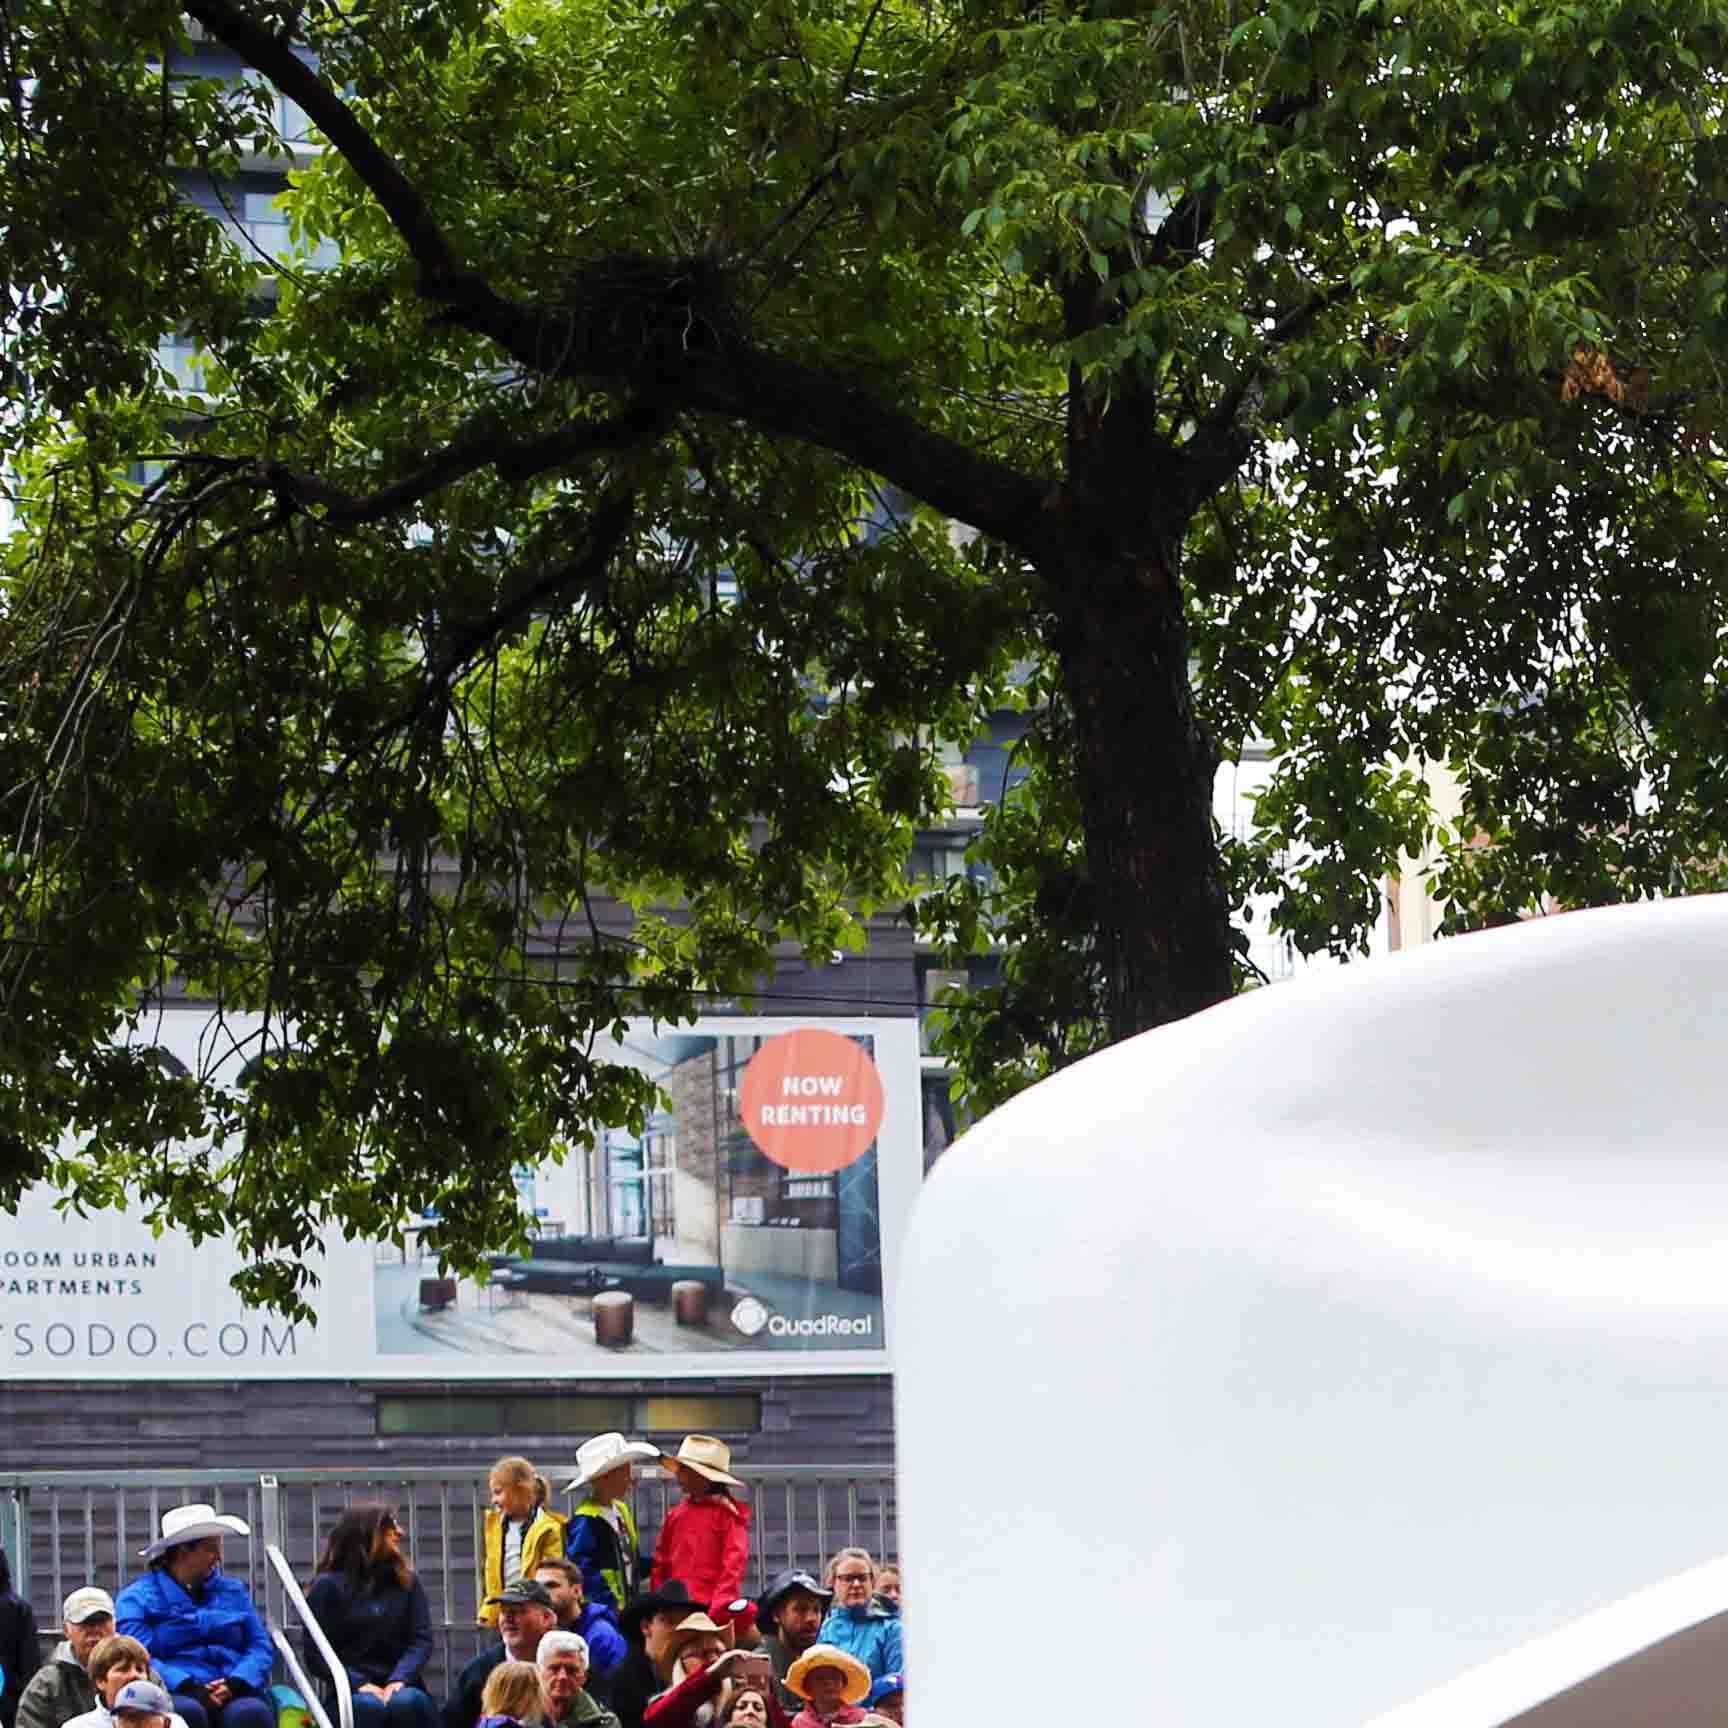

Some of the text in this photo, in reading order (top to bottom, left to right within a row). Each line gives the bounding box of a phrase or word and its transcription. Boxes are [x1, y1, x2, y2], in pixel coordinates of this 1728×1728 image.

[783, 1076, 842, 1096] NOW
[761, 1104, 866, 1125] RENTING
[0, 1251, 157, 1268] OOM URBAN
[768, 1314, 872, 1336] QuadReal
[0, 1322, 297, 1357] SODO.COM
